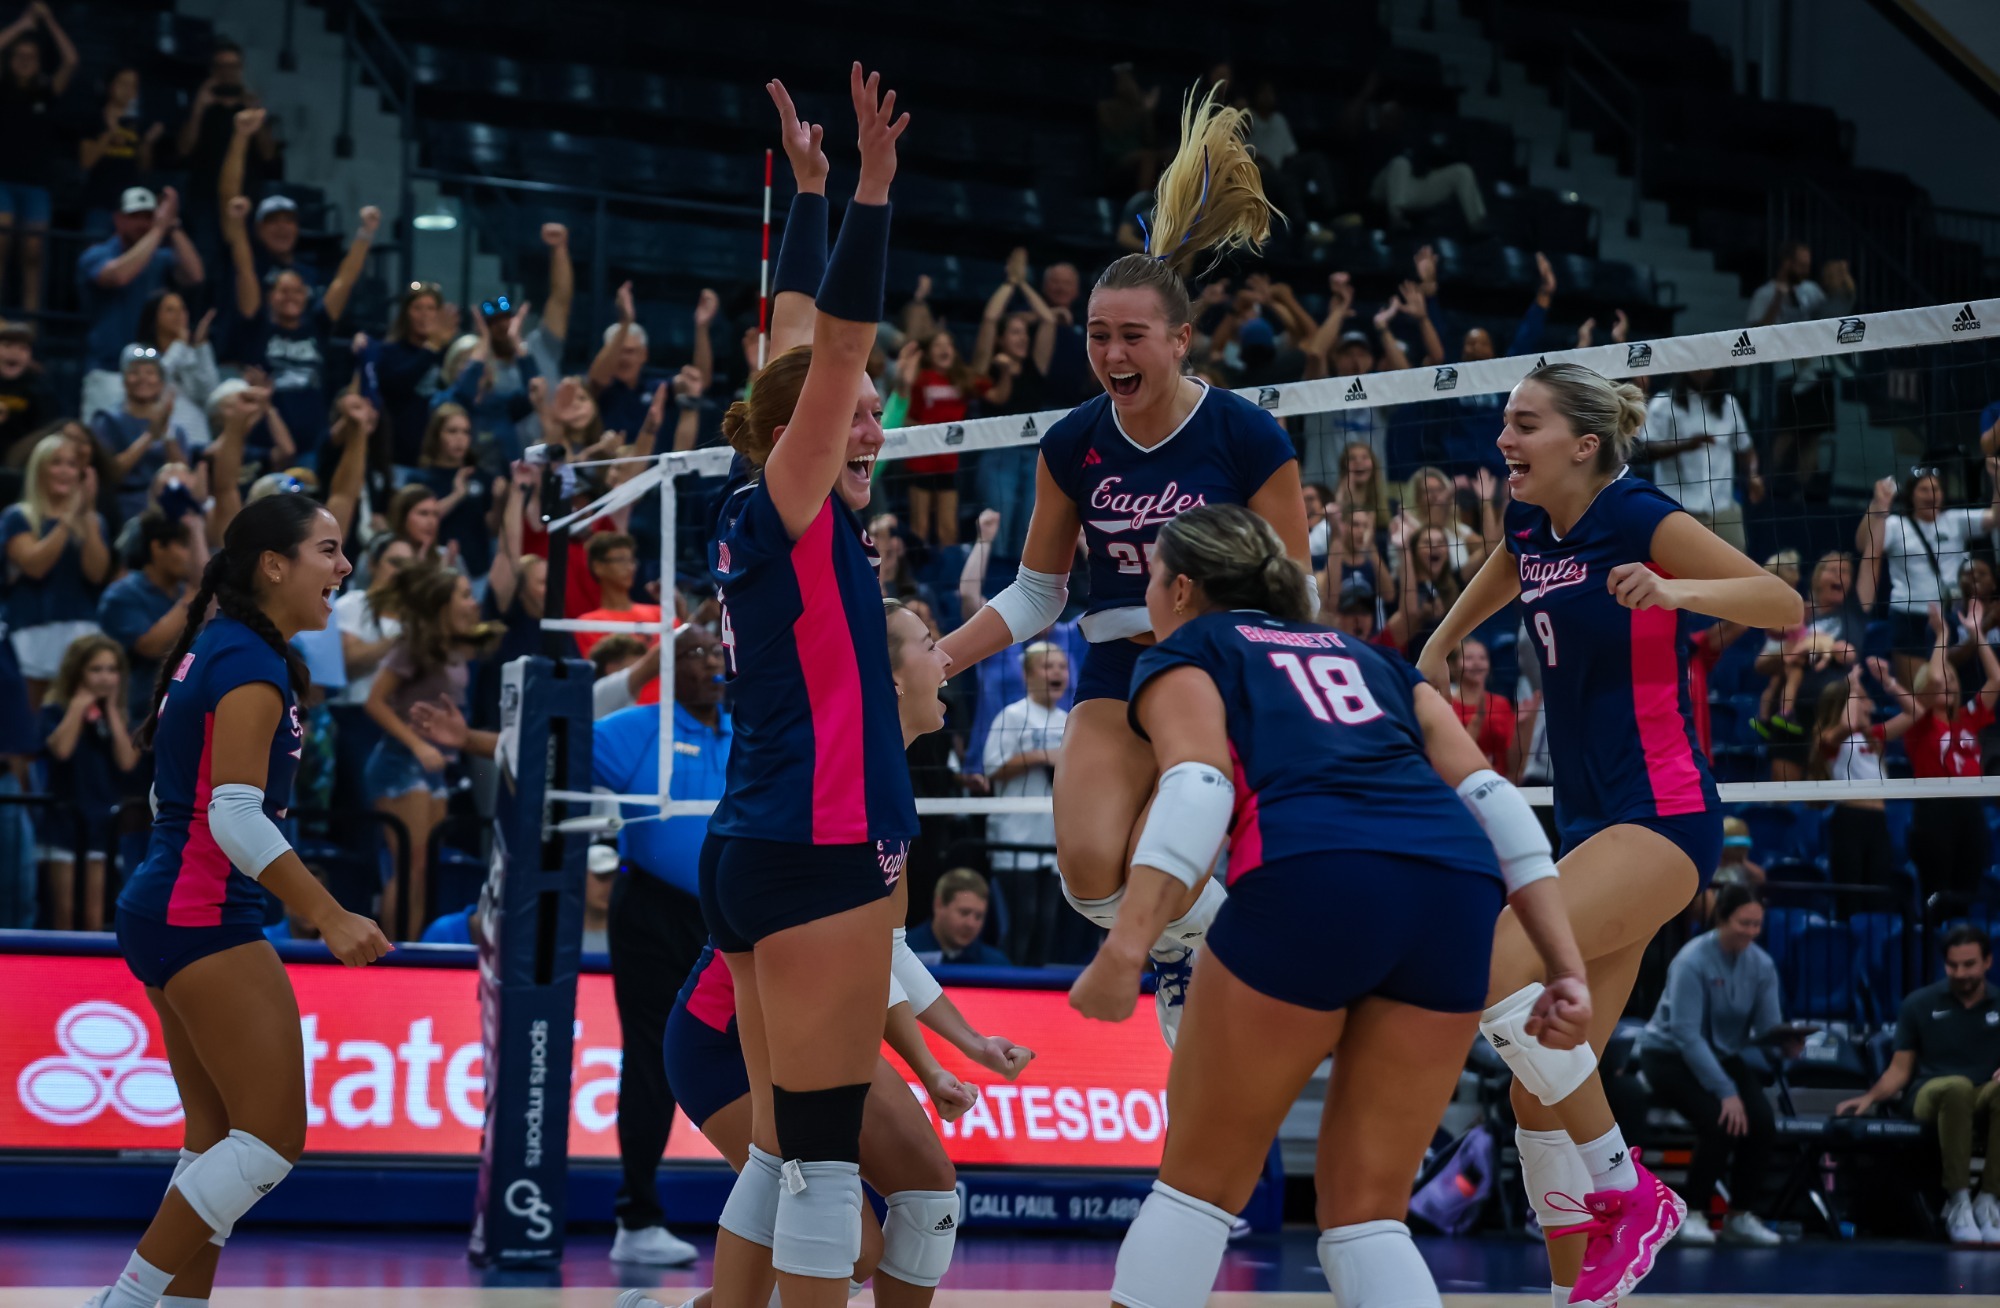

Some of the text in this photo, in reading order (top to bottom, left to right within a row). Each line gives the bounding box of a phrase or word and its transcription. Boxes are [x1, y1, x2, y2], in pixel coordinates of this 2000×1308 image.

[1731, 345, 1757, 357] adidas
[1951, 320, 1981, 332] adidas
[1344, 392, 1368, 402] adidas
[1519, 552, 1589, 598] Eagles
[1532, 610, 1558, 668] 9
[1267, 651, 1387, 727] 18
[300, 1013, 487, 1130] tate
[528, 1019, 549, 1086] sports
[908, 1083, 1169, 1142] ATESBO
[969, 1194, 1012, 1218] CALL
[1014, 1195, 1059, 1219] PAUL
